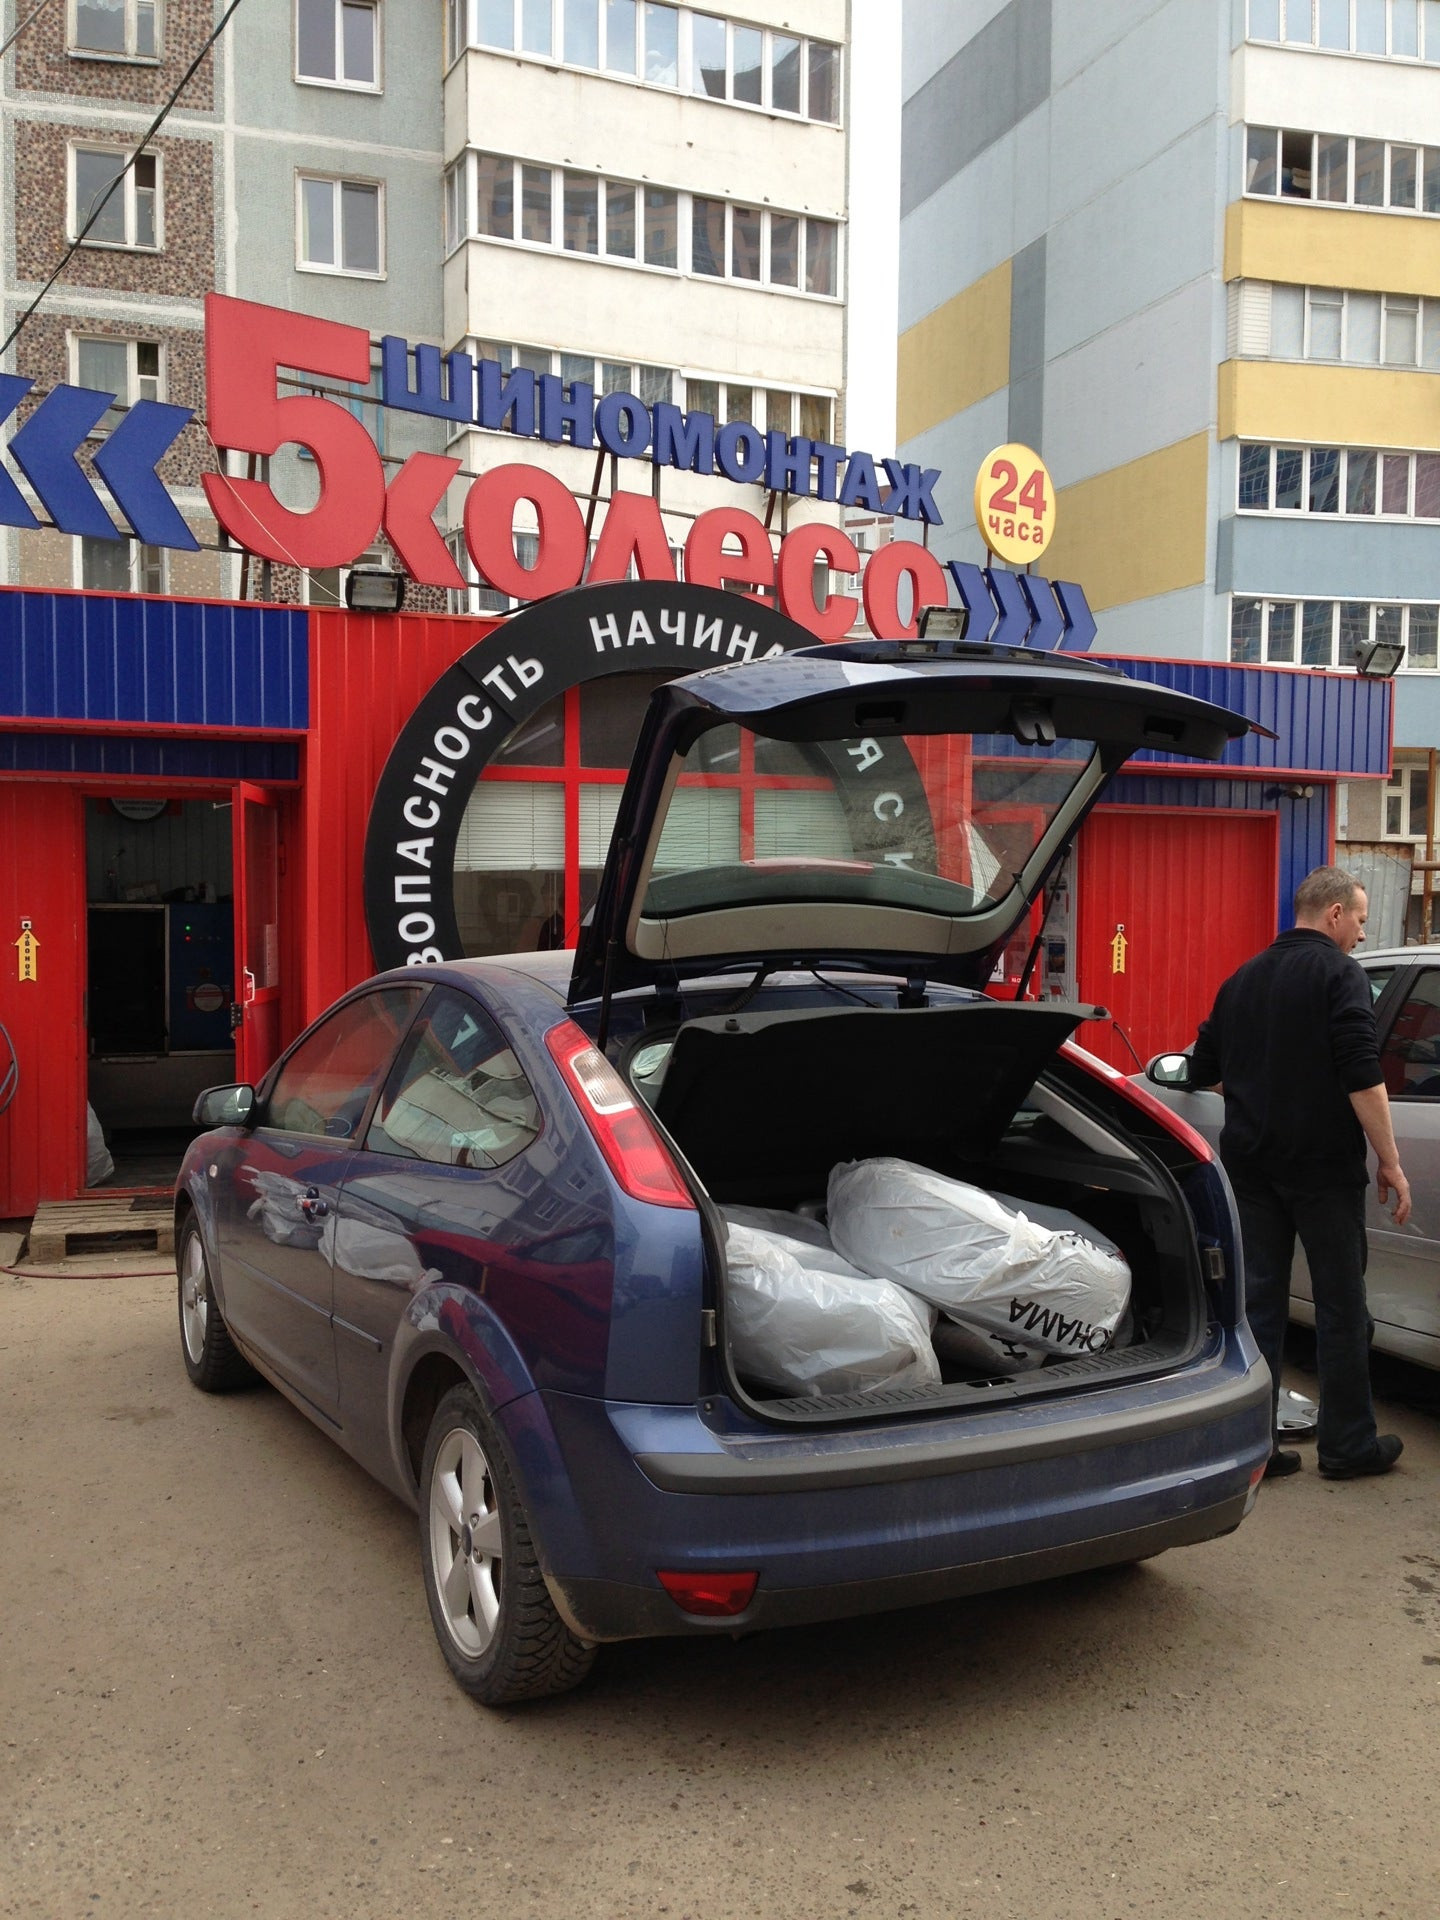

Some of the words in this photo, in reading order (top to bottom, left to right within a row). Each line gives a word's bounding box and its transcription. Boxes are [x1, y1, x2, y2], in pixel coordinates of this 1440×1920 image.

[382, 335, 943, 525] ШИНОМОНТАЖ
[988, 458, 1047, 520] 24
[988, 513, 1044, 545] часа
